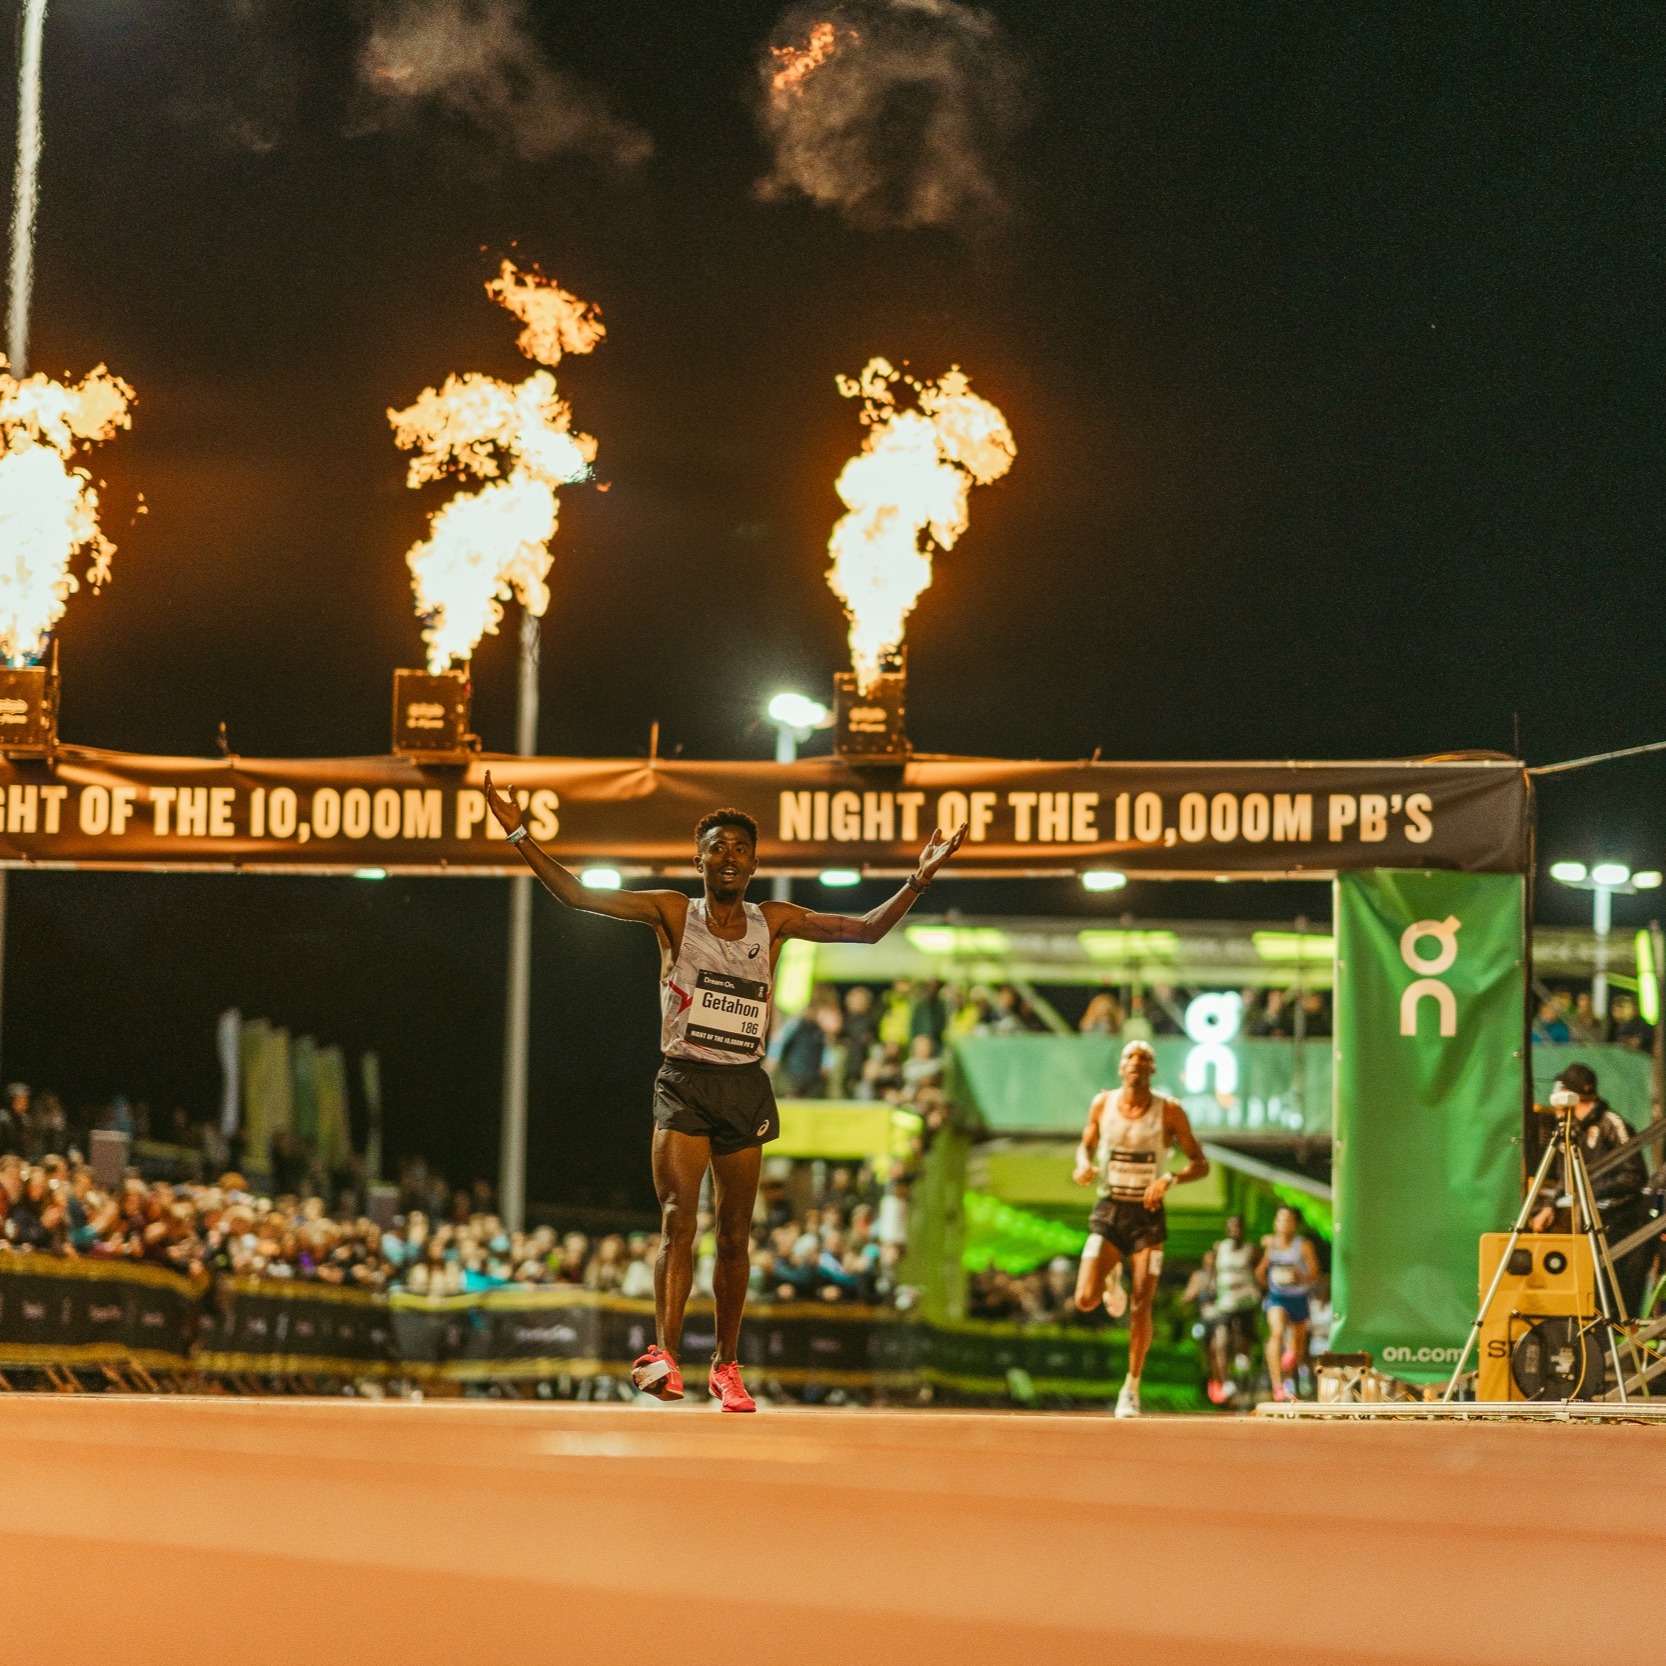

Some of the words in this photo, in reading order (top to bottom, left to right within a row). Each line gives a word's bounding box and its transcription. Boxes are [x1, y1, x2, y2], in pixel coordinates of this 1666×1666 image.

[0, 785, 68, 834] HT
[79, 785, 137, 835] OF
[150, 787, 236, 836] THE
[251, 787, 442, 843] 10,000M
[780, 791, 925, 841] NIGHT
[937, 791, 996, 841] OF
[1008, 792, 1099, 841] THE
[1115, 792, 1312, 847] 10,000M
[1329, 793, 1433, 843] PB'S
[703, 977, 724, 987] Dream
[702, 992, 759, 1018] Getahon
[741, 1021, 759, 1035] 186
